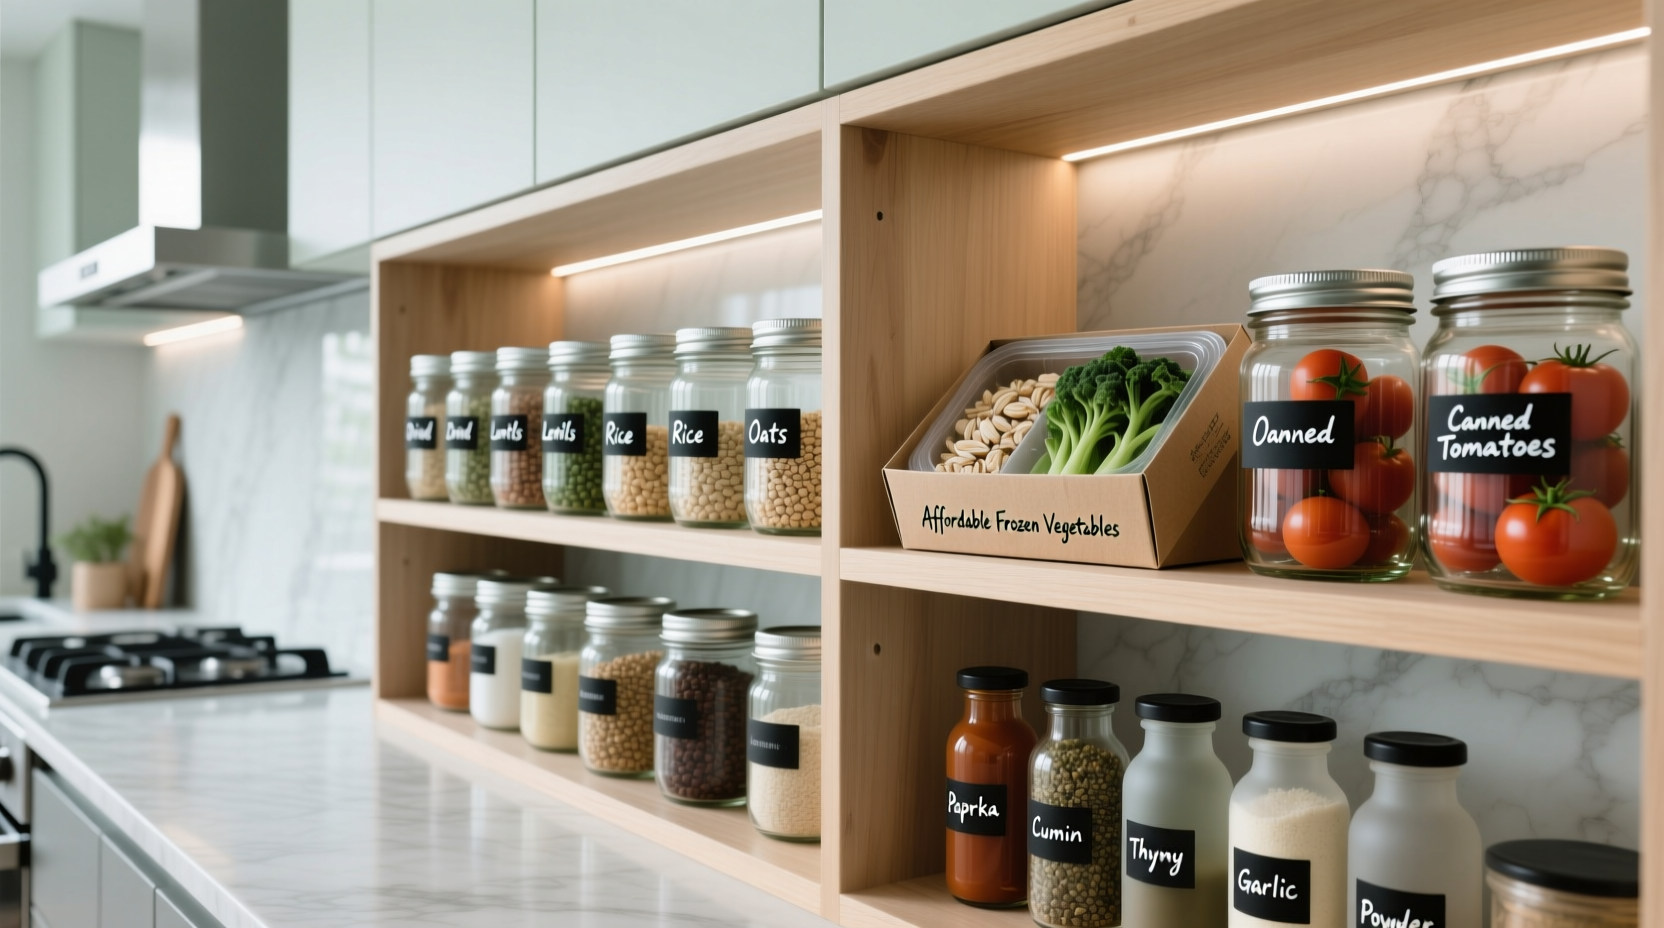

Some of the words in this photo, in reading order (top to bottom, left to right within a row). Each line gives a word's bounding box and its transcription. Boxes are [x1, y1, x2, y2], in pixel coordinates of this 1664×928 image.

[672, 419, 704, 445] Rice
[748, 418, 788, 445] Oats
[1252, 415, 1335, 447] Oanned
[1447, 403, 1534, 432] Canned
[605, 420, 634, 446] Rice
[1437, 432, 1557, 461] Tomatoes
[922, 505, 992, 535] Affordable
[995, 509, 1040, 533] Frozen
[1043, 512, 1120, 544] Vegetables
[947, 790, 1000, 824] Paprka
[1032, 815, 1082, 843] Cumin
[1237, 868, 1299, 900] Garlic
